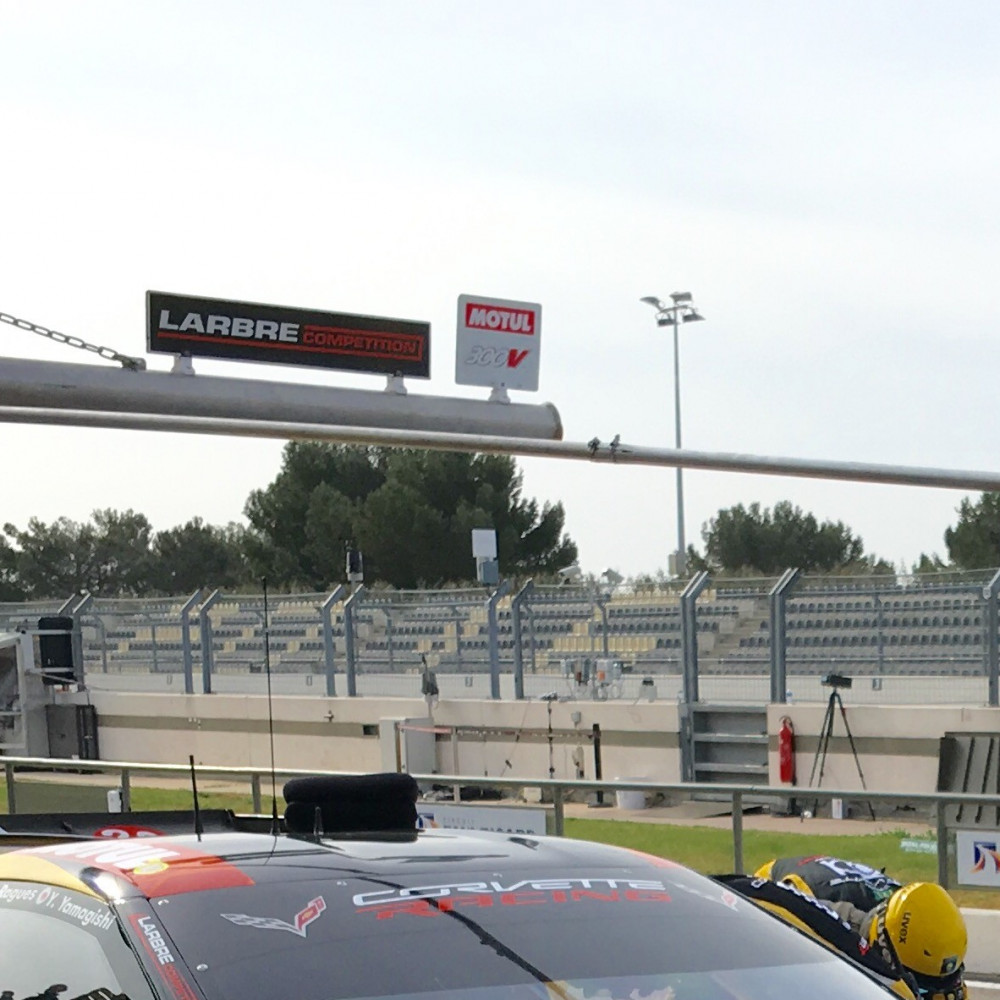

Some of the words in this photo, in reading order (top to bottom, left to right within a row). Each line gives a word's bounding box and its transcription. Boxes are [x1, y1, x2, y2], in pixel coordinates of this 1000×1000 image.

[158, 309, 300, 344] LARBRE
[303, 332, 416, 355] COMPETITION
[468, 307, 532, 333] MOTUL
[352, 878, 667, 906] CORVETTE
[355, 889, 672, 920] RACING
[57, 895, 116, 931] Yamagishi
[137, 916, 175, 966] LARBRE
